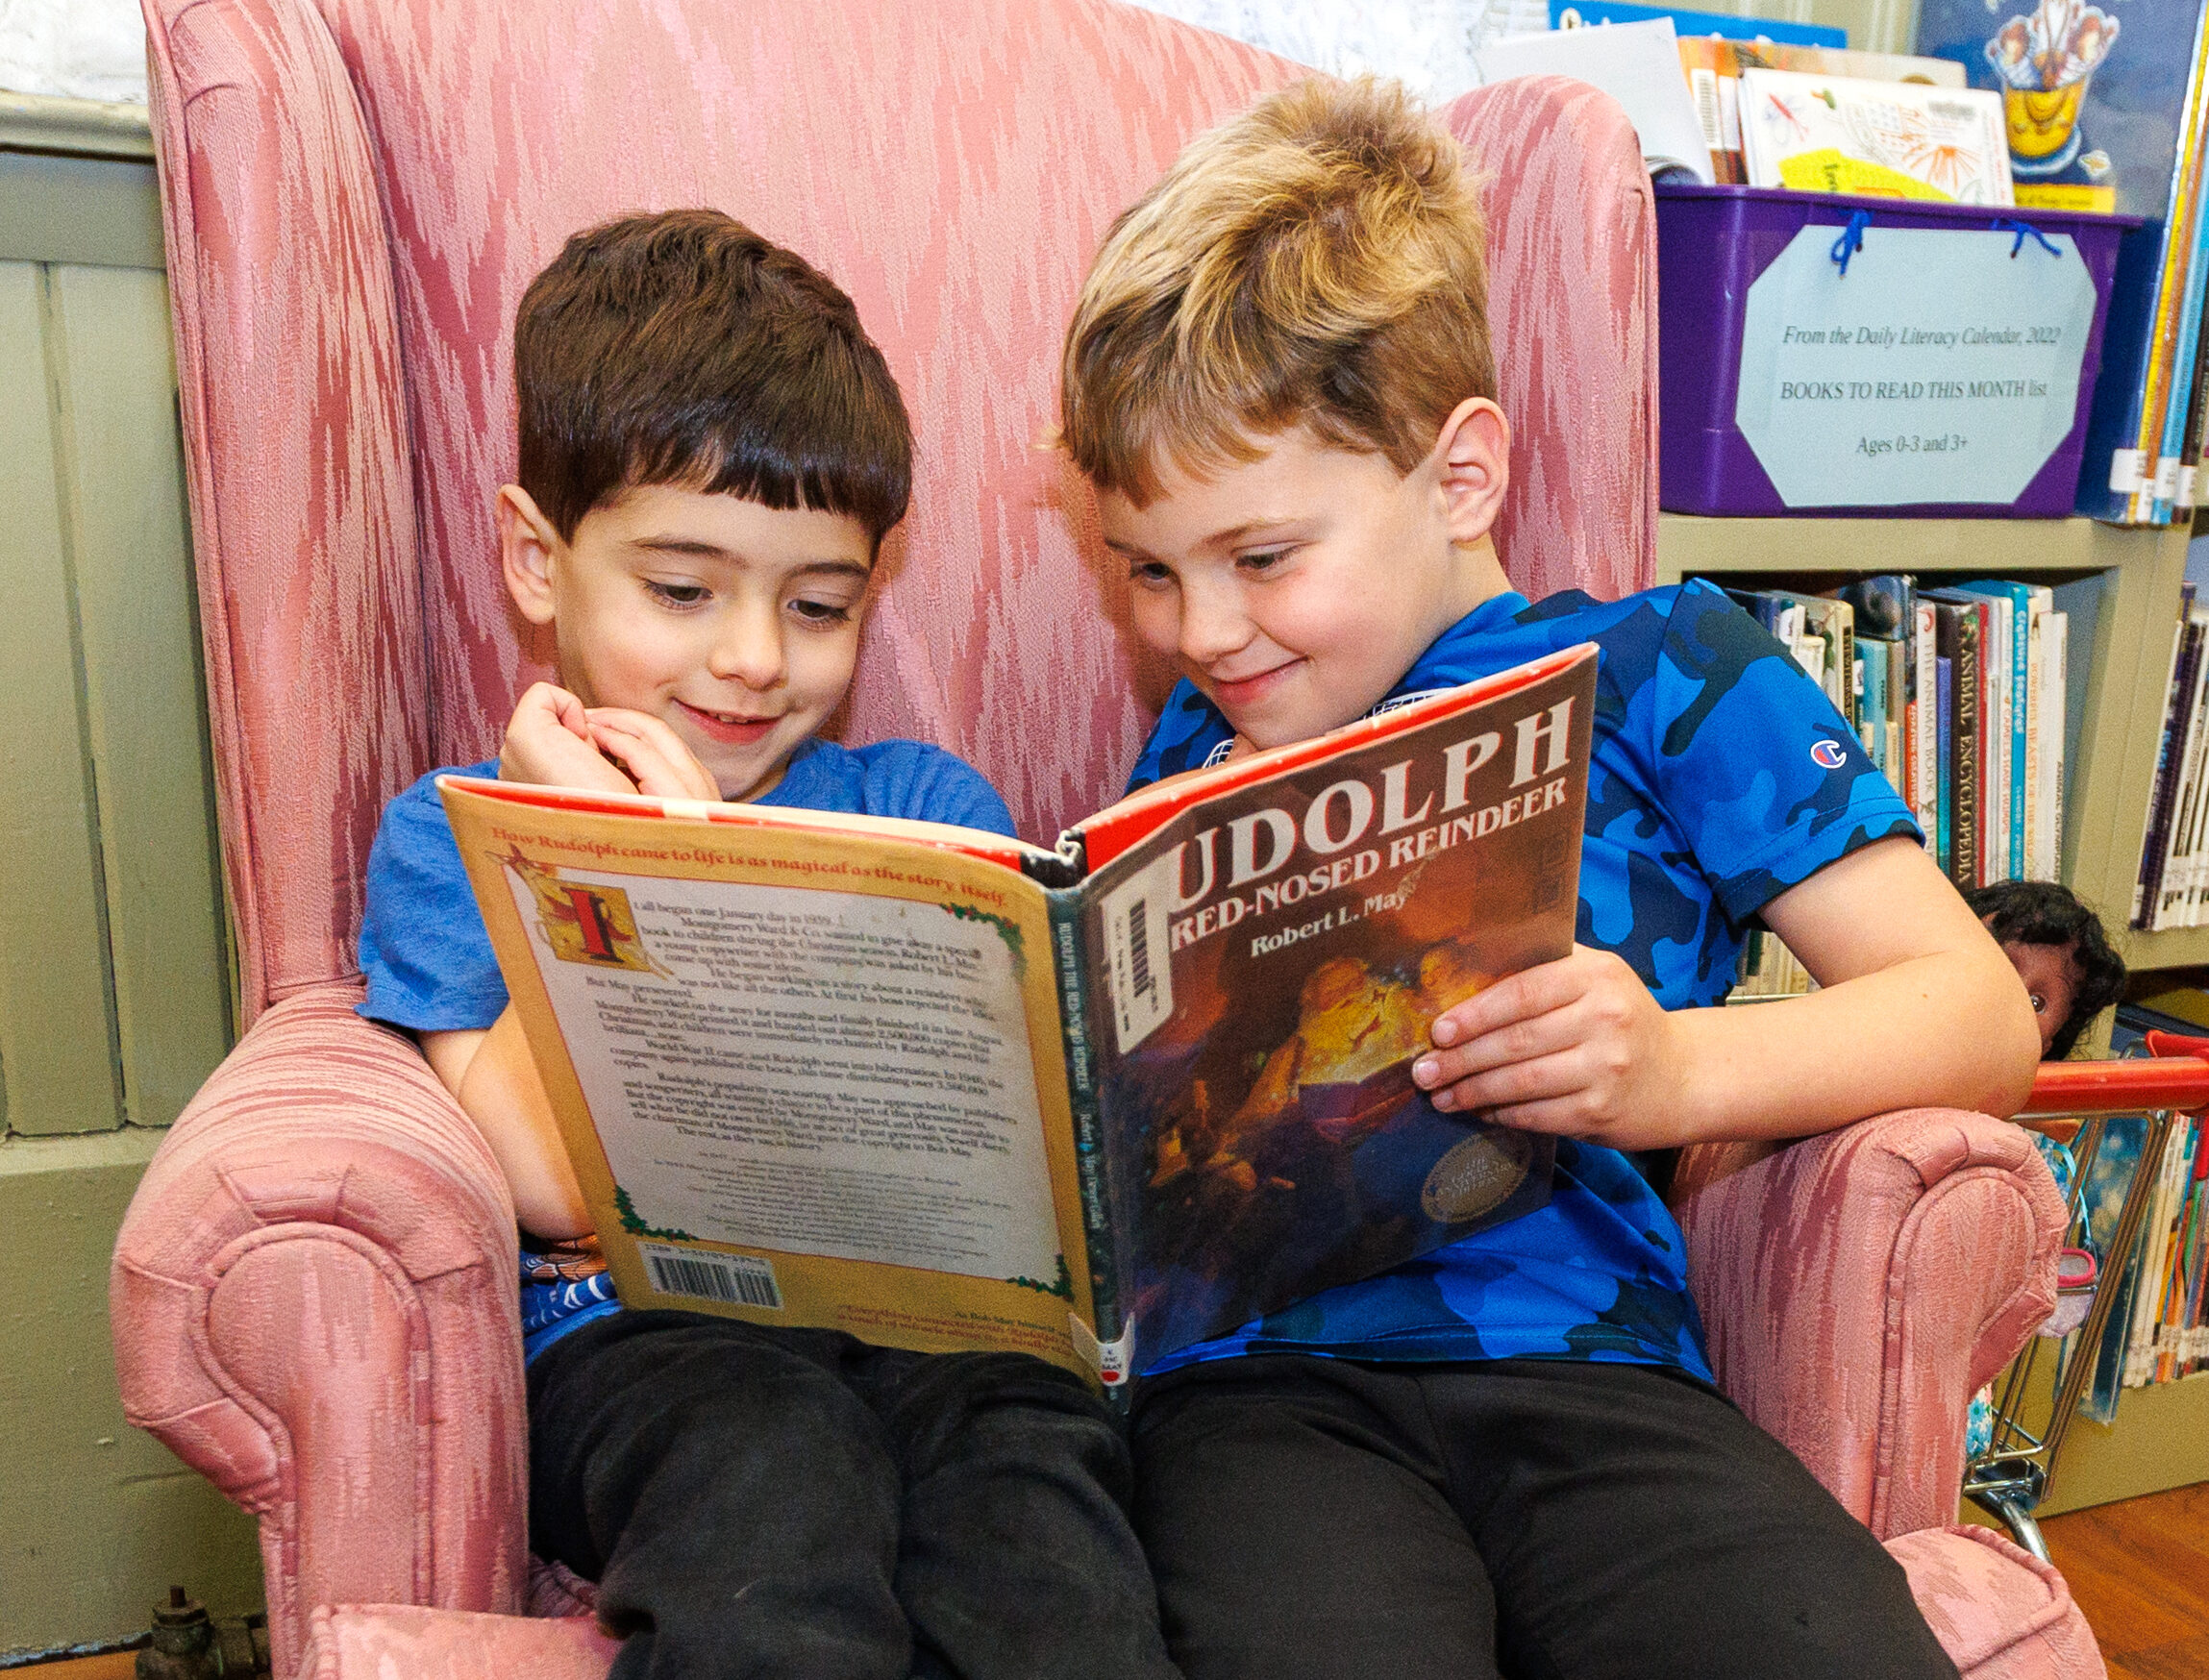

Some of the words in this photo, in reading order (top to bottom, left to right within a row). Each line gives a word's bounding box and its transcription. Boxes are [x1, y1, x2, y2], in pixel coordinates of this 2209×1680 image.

[1782, 326, 1825, 344] From
[1829, 327, 1852, 344] the
[1855, 327, 1897, 349] Daily
[1899, 327, 1958, 349] Literacy
[1962, 327, 2023, 347] Calendar,
[2025, 327, 2061, 344] 2022
[1780, 382, 1843, 399] BOOKS
[1849, 382, 1873, 399] TO
[1875, 382, 1923, 399] READ
[1927, 382, 1963, 398] THIS
[1968, 381, 2024, 398] MONTH
[2029, 380, 2047, 396] list
[1855, 436, 1892, 457] Ages
[1896, 436, 1920, 453] 0-3
[1923, 434, 1947, 452] and
[1950, 434, 1968, 452] 3+
[1924, 643, 1935, 672] THE
[1960, 648, 1974, 726] ANIMAL
[1924, 679, 1935, 743] ANIMAL
[2001, 708, 2012, 757] CAMELS
[1924, 748, 1935, 793] BOOK
[2001, 759, 2011, 792] HAVE
[2027, 727, 2038, 779] BEASTS
[1166, 697, 1576, 913] UDOLPH
[2027, 783, 2037, 797] OF
[2055, 760, 2064, 810] ANIMAL
[1958, 734, 1974, 885] ENCYCLOPEDIA
[2000, 794, 2010, 835] HUMPS
[2027, 803, 2036, 825] THE
[491, 827, 532, 845] How
[538, 834, 619, 860] Rudolph
[621, 846, 669, 861] came
[672, 849, 690, 862] to
[693, 850, 725, 869] life
[727, 851, 742, 865] is
[747, 855, 768, 868] as
[771, 857, 848, 876] magical
[851, 865, 871, 877] as
[874, 867, 905, 882] the
[907, 873, 955, 892] story
[1170, 849, 1381, 952] RED-NOSED
[1389, 777, 1568, 868] REINDEER
[560, 886, 625, 964] I
[1058, 922, 1076, 968] RUDOLPH
[1251, 912, 1335, 958] Robert
[1338, 904, 1361, 930] L.
[1363, 890, 1408, 918] May
[1062, 969, 1079, 988] THE
[593, 999, 663, 1019] Montgomery
[644, 1037, 678, 1051] World
[772, 1051, 821, 1068] Rudolph
